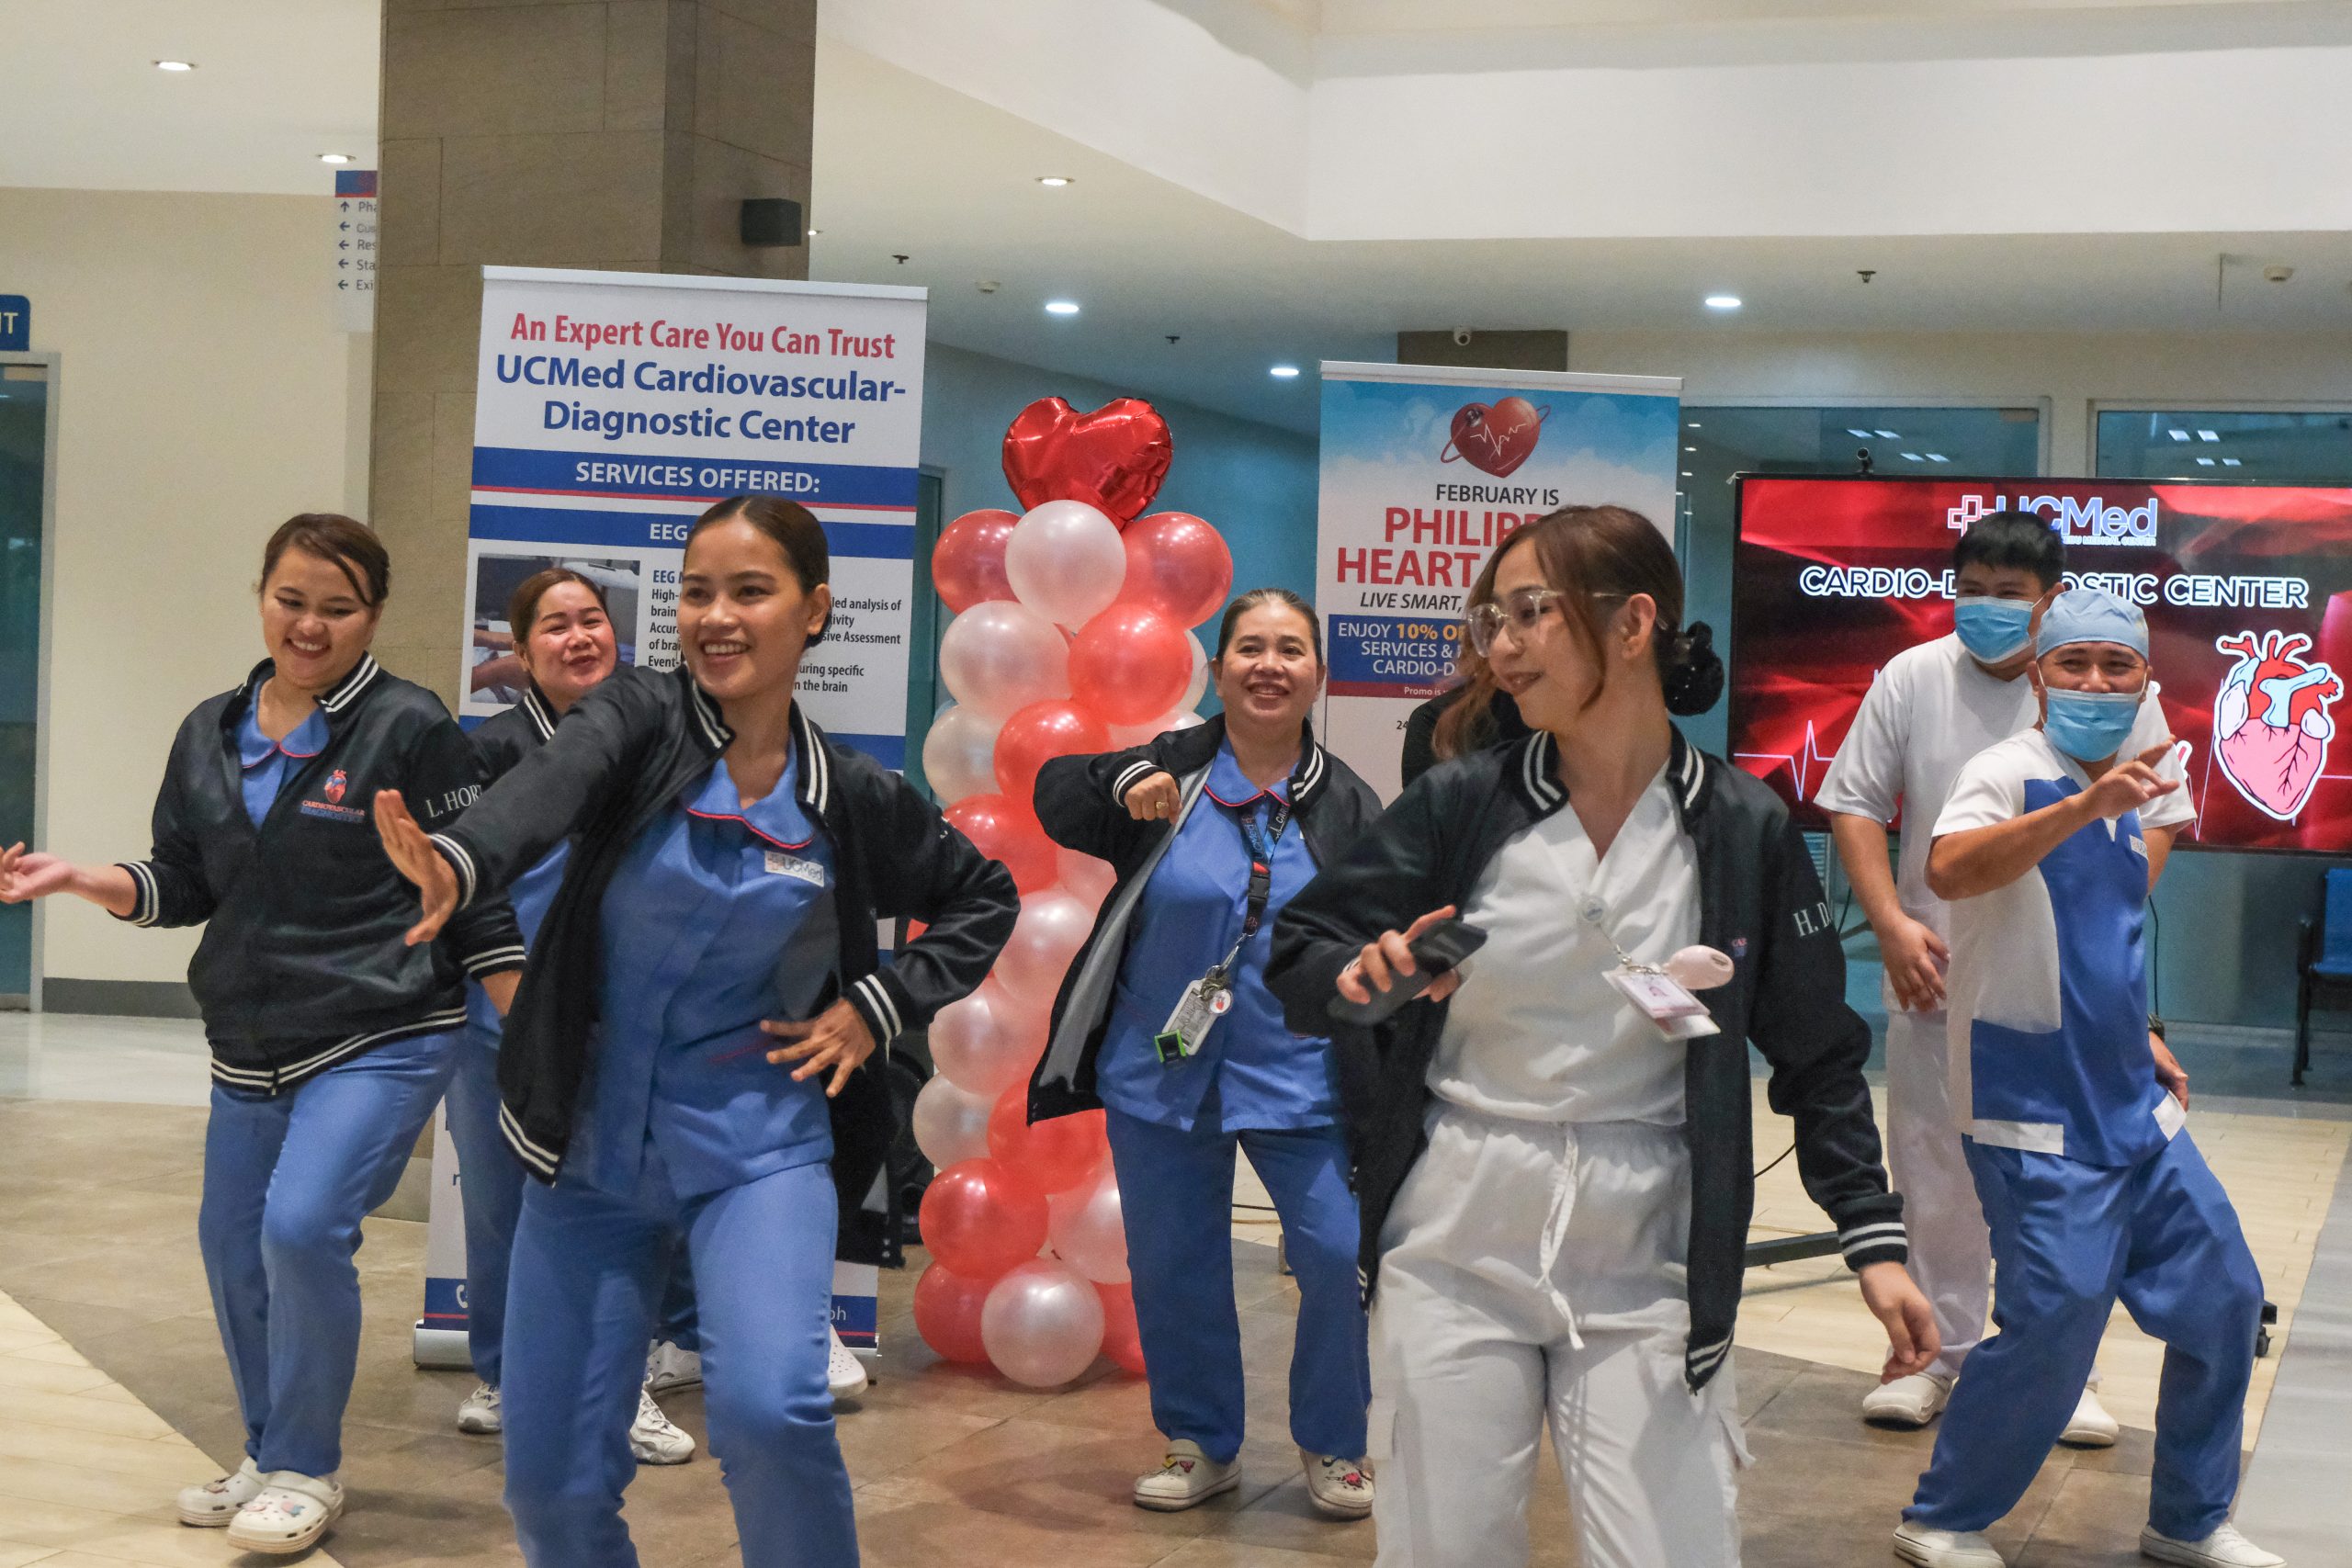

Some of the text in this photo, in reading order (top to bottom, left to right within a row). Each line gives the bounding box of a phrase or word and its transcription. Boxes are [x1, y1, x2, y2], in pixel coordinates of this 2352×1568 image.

[511, 313, 896, 359] An Expert Care You Can Trust
[497, 355, 906, 402] UCMed Cardiovascular-
[544, 400, 855, 444] Diagnostic Center
[576, 462, 820, 493] SERVICES OFFERED:
[1436, 484, 1559, 505] FEBRUARY IS
[650, 524, 688, 541] EEG
[653, 570, 675, 583] EEG
[1337, 547, 1481, 588] HEART
[652, 589, 681, 603] High-
[849, 598, 888, 613] analysis
[891, 600, 902, 611] of
[2165, 574, 2309, 609] CENTER
[651, 605, 678, 617] brain
[1360, 592, 1462, 613] LIVE SMART,
[843, 631, 900, 644] Assessment
[1338, 622, 1391, 638] ENJOY
[1396, 623, 1438, 640] 10%
[649, 639, 660, 649] of
[1362, 641, 1437, 658] SERVICES
[1441, 644, 1453, 659] &
[828, 664, 865, 678] specific
[803, 680, 820, 691] the
[822, 680, 848, 692] brain
[1404, 686, 1432, 695] Promo
[426, 799, 444, 818] L.
[1793, 908, 1819, 937] H.
